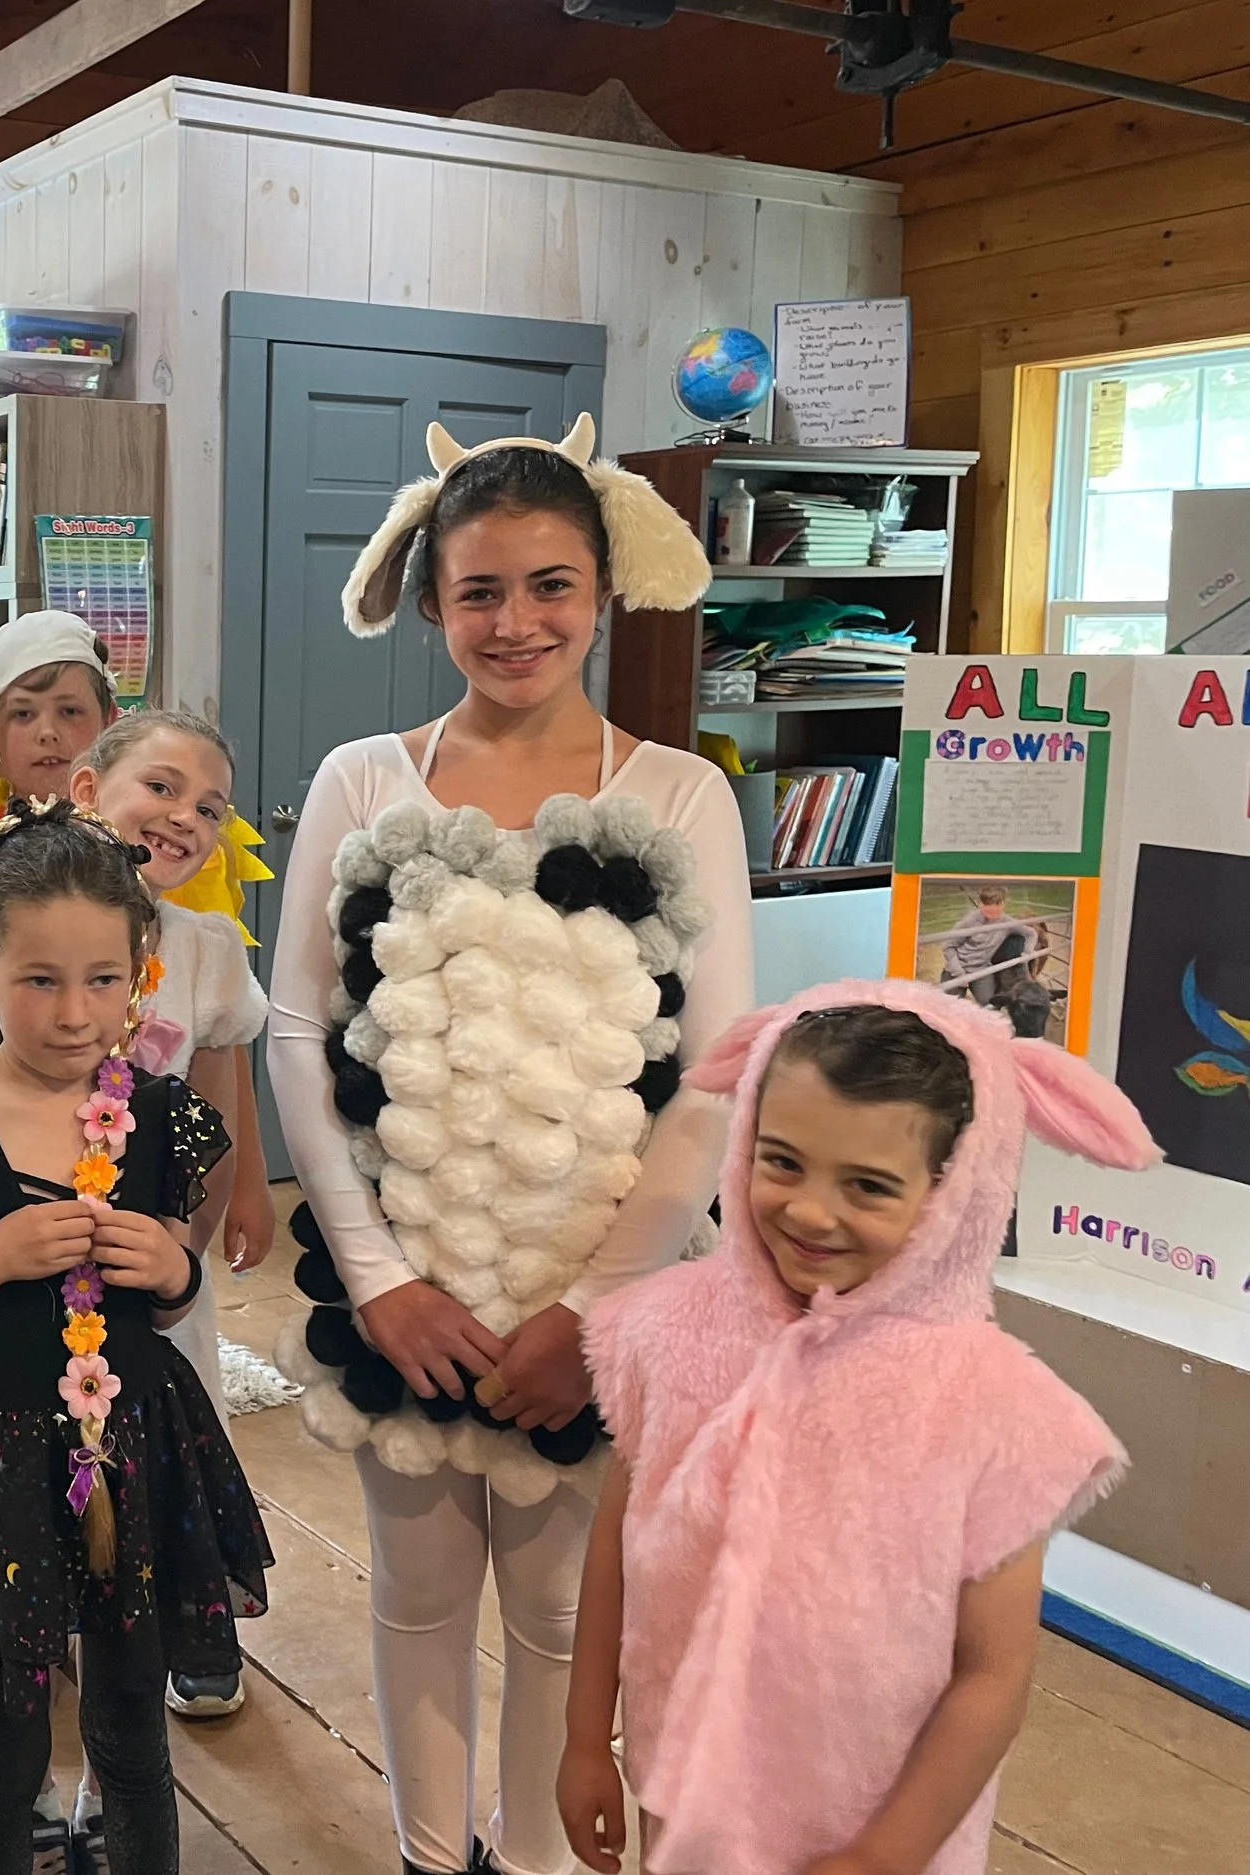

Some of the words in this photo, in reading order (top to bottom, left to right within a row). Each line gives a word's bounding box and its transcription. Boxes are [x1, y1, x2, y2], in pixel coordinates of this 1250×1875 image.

[847, 380, 864, 391] of
[945, 665, 1111, 728] ALL
[1178, 669, 1250, 728] A
[1052, 1205, 1216, 1280] Harrison
